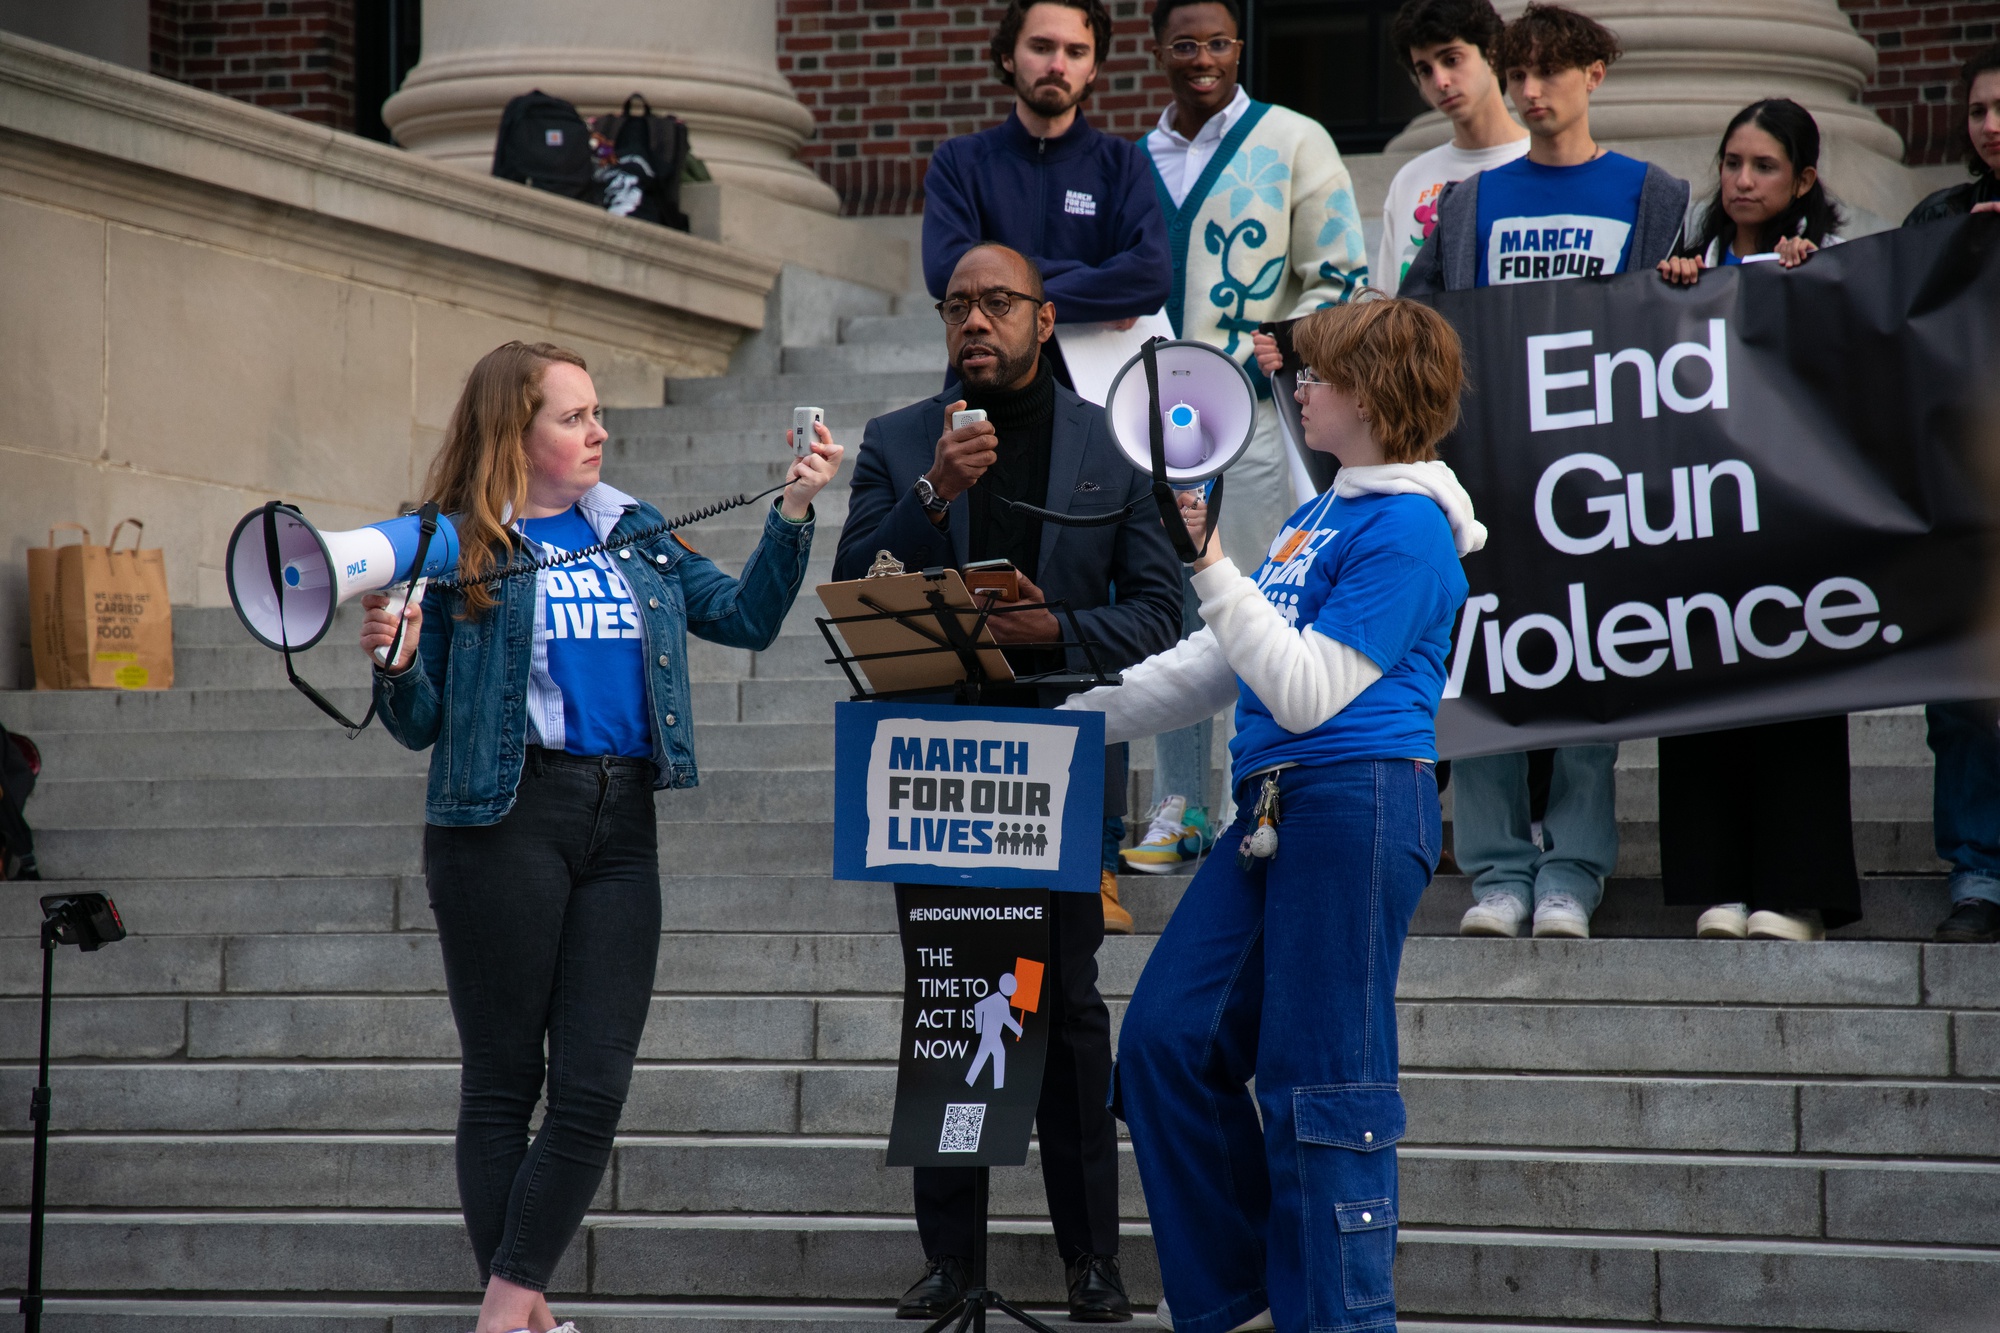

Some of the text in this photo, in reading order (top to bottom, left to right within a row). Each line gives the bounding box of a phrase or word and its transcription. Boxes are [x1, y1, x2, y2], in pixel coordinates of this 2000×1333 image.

[1065, 198, 1096, 210] FOR OUR
[1066, 189, 1093, 201] MARCH
[1064, 205, 1085, 215] LIVES
[1500, 228, 1594, 254] MARCH
[1500, 253, 1605, 280] FOR OUR
[1527, 318, 1729, 432] End
[1534, 452, 1760, 555] Gun
[346, 558, 367, 578] PYLE
[546, 568, 606, 599] OR
[95, 602, 144, 615] CARRIED
[888, 736, 1029, 775] MARCH
[888, 776, 1051, 817] FOR OUR
[888, 816, 994, 855] LIVES
[909, 906, 1043, 922] #ENDGUNVIOLENCE
[917, 947, 954, 967] THE
[917, 978, 989, 998] TIME TO
[915, 1009, 975, 1029] ACT IS
[913, 1040, 970, 1060] NOW
